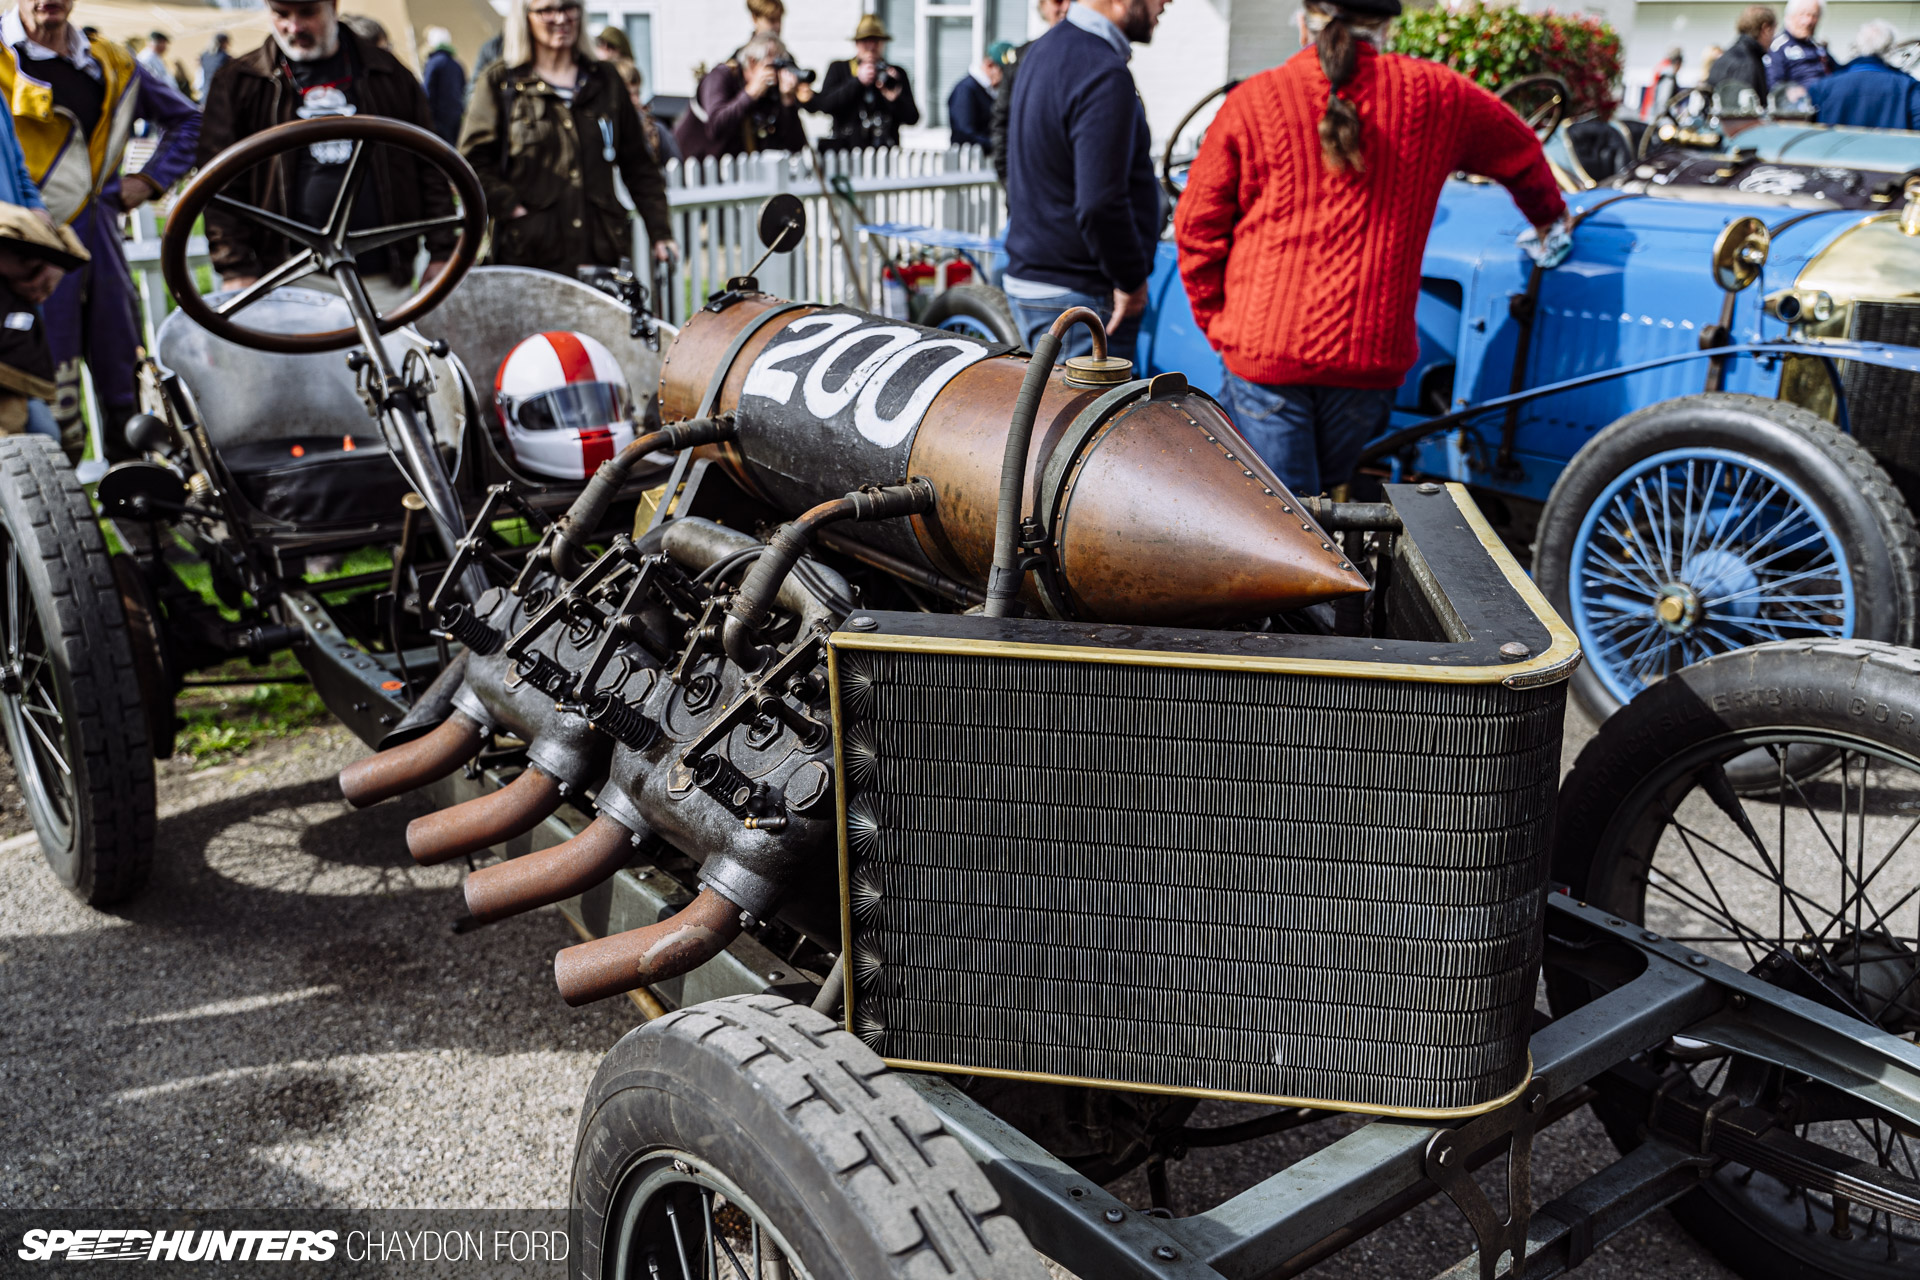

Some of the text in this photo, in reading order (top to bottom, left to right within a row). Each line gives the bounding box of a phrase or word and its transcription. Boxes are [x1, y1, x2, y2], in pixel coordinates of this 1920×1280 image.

[743, 313, 988, 449] 200
[1570, 686, 1920, 830] GOODRICH SILVERTOWN COR
